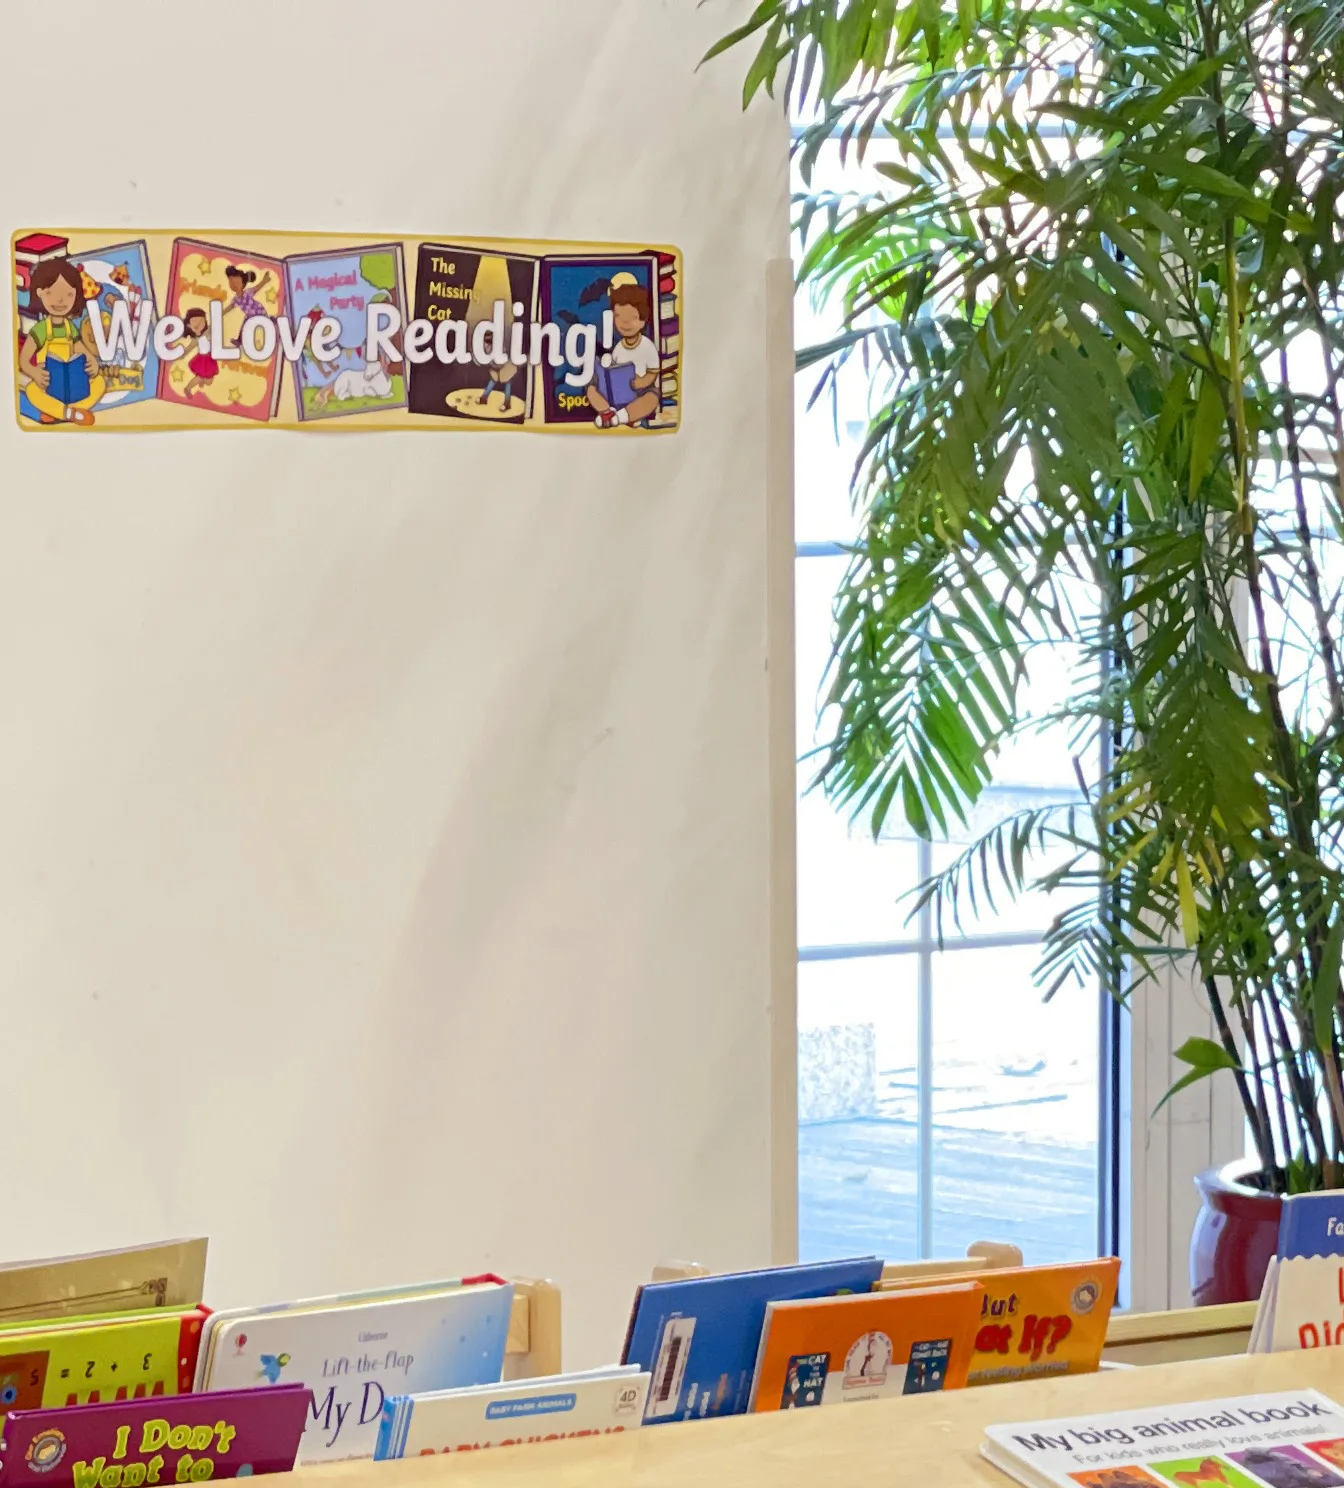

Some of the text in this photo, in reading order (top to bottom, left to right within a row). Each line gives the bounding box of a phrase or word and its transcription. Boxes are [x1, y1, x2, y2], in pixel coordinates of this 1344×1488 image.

[430, 256, 456, 275] The
[295, 270, 357, 292] A Magical
[429, 281, 481, 302] Missing
[329, 296, 365, 312] Party
[427, 304, 452, 321] Cat
[86, 299, 615, 388] We Love Reading!
[1017, 1313, 1072, 1361] If?
[322, 1350, 415, 1377] Lift-the-flap
[808, 1354, 827, 1365] CAT
[537, 1398, 573, 1409] ANIMALS
[618, 1390, 637, 1403] 4D
[310, 1385, 353, 1448] My
[1012, 1400, 1333, 1451] My big animal book
[112, 1418, 236, 1459] I Don't
[1182, 1437, 1225, 1449] really
[175, 1453, 215, 1482] to
